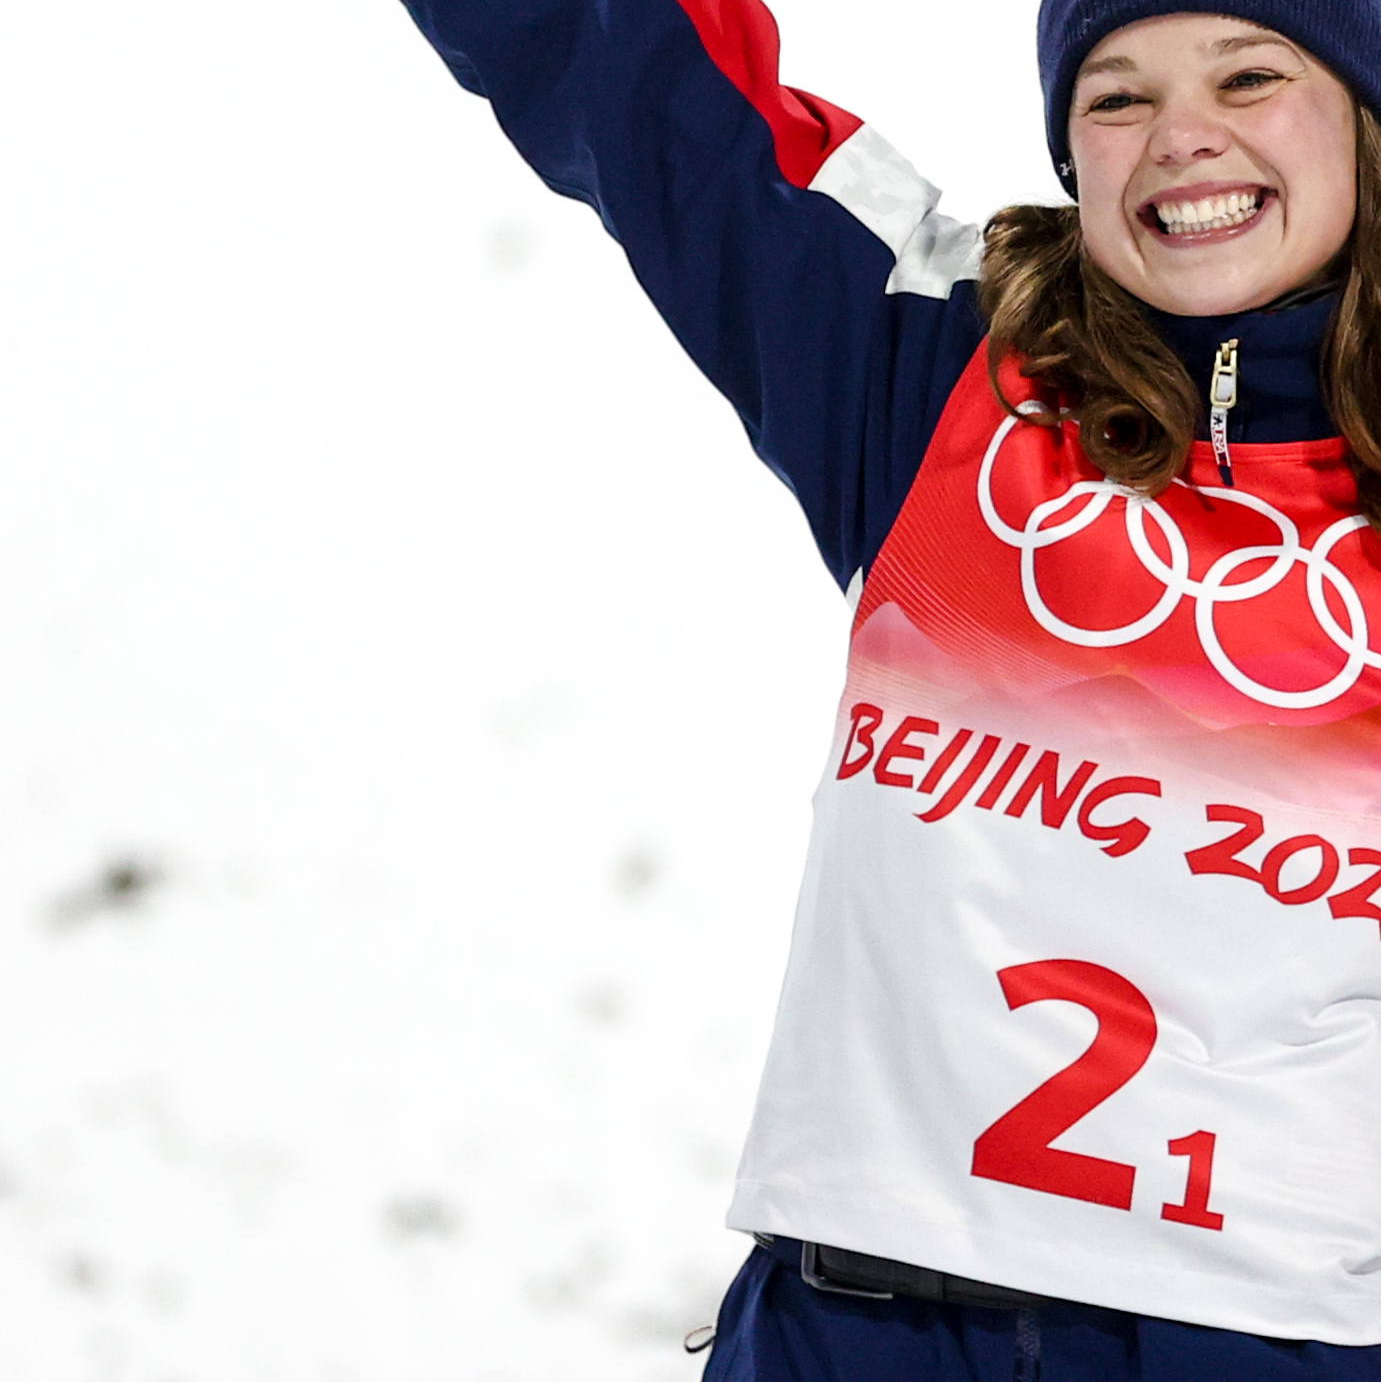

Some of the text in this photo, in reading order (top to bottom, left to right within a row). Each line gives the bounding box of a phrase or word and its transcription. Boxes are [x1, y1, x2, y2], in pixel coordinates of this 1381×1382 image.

[836, 702, 1162, 857] BEIJING
[970, 958, 1224, 1231] 2 1
